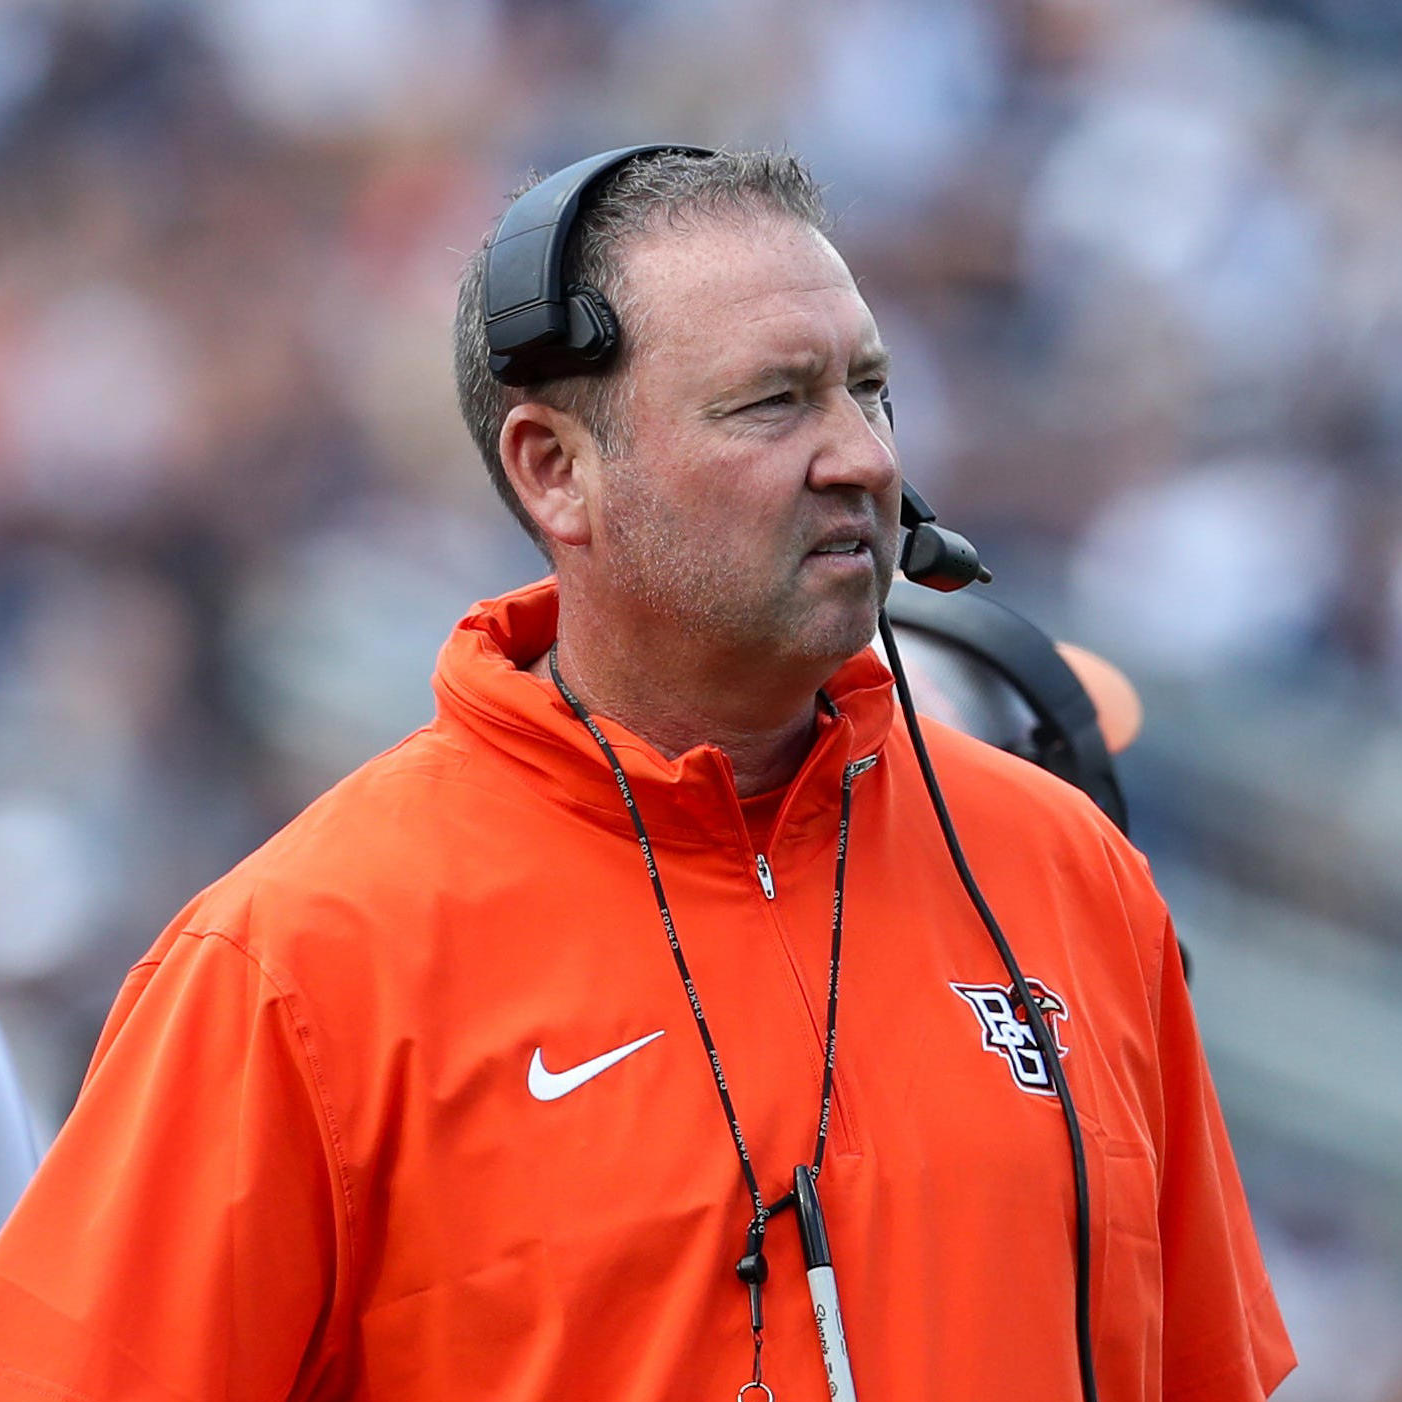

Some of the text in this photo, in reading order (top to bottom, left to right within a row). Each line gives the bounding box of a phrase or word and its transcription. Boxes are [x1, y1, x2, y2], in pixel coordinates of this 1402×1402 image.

[614, 767, 633, 808] FOX40
[639, 836, 657, 878] FOX40
[660, 907, 679, 950] FOX40
[685, 979, 704, 1020] FOX40
[709, 1049, 728, 1090] FOX40
[753, 1191, 766, 1234] FOX40
